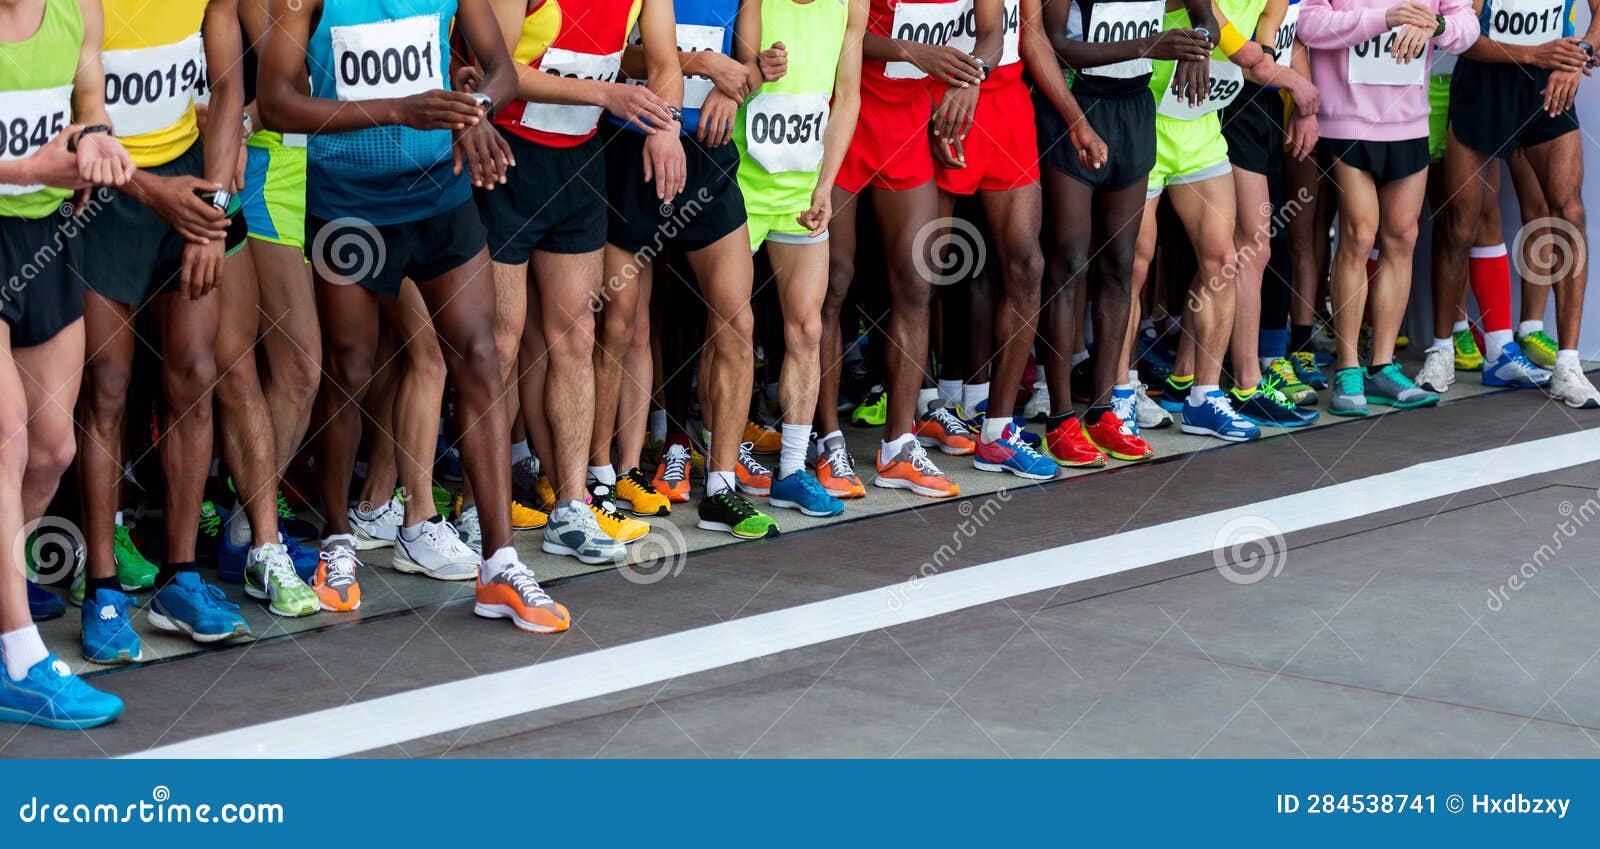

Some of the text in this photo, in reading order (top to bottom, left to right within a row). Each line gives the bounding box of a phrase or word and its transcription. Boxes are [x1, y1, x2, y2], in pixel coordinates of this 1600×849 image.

[1494, 5, 1562, 35] 00017
[340, 41, 433, 86] 00001
[751, 111, 824, 144] 00351
